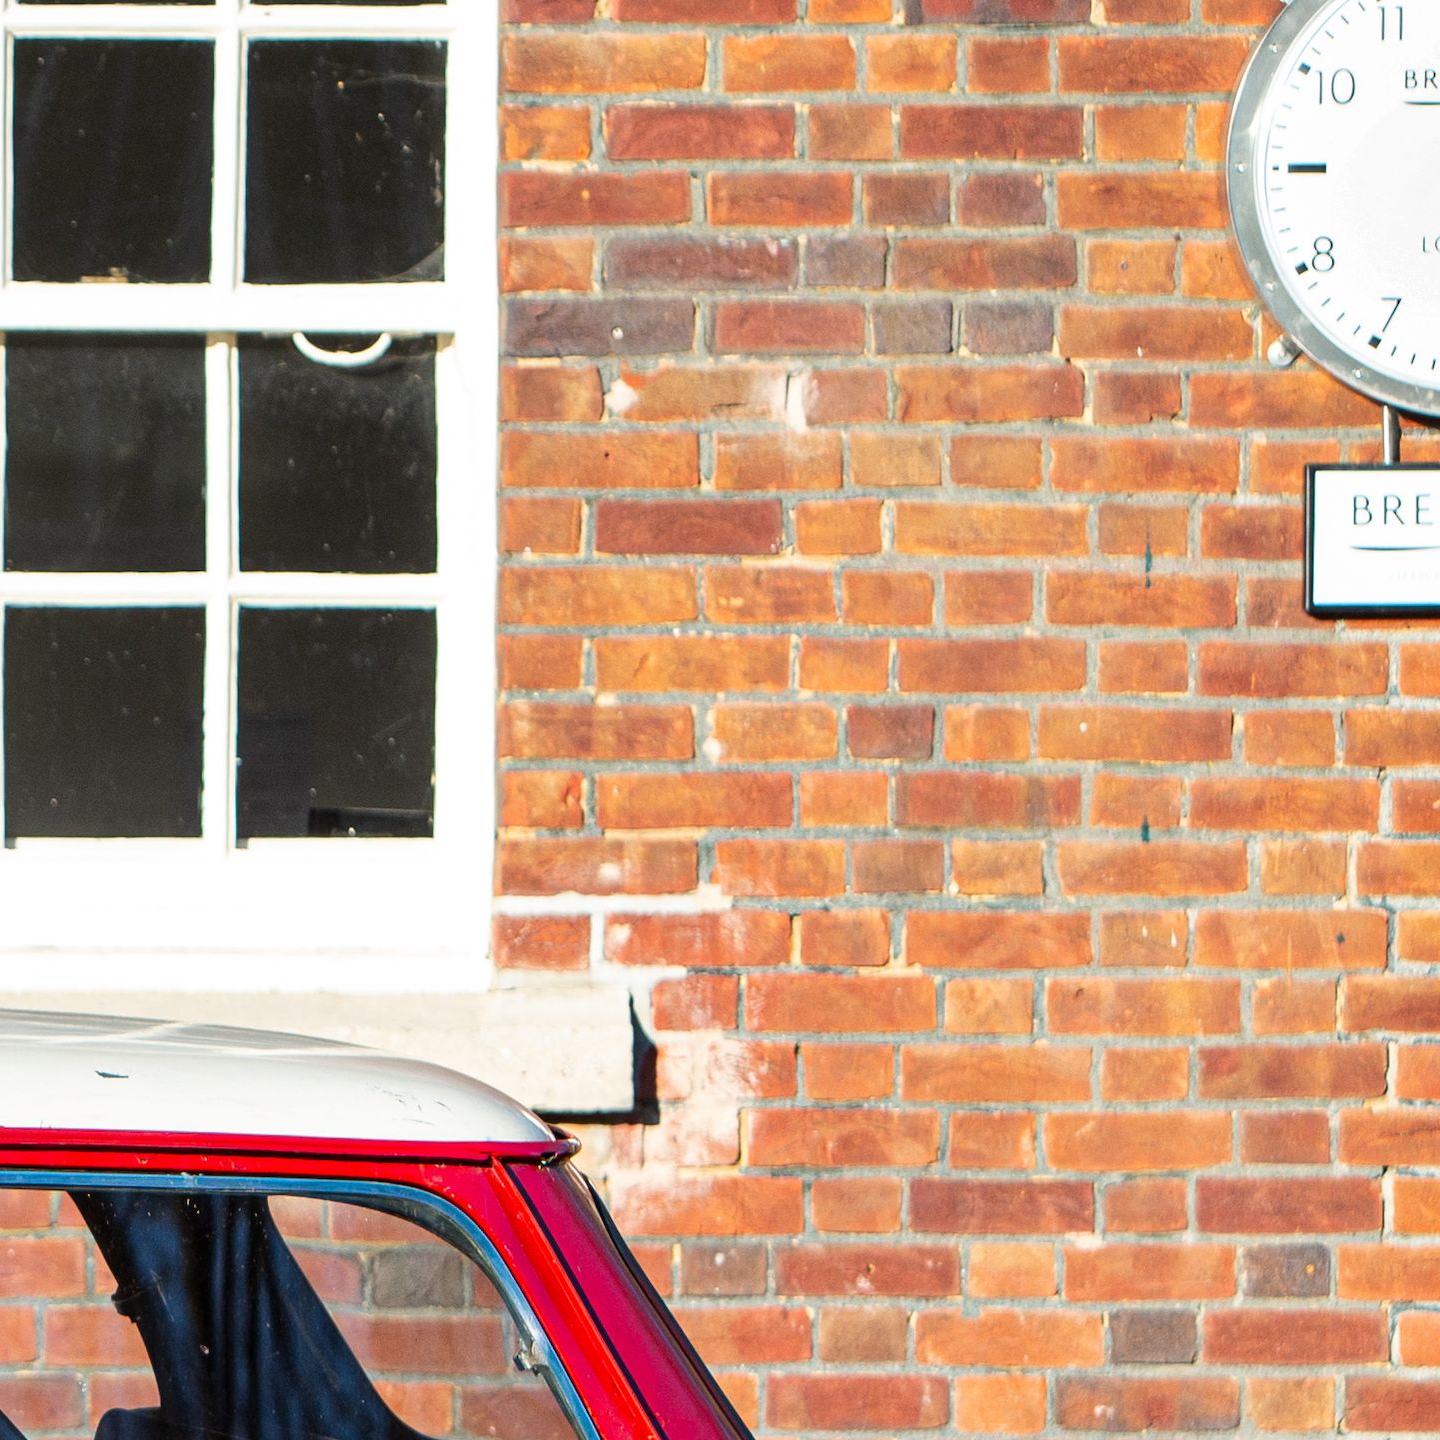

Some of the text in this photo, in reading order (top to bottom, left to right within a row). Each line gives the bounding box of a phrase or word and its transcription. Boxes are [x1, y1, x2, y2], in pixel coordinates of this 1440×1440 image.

[1377, 5, 1404, 41] 11
[1315, 67, 1356, 105] 10
[1310, 235, 1335, 273] 8
[1380, 296, 1403, 333] 7
[1352, 493, 1434, 526] BRE
